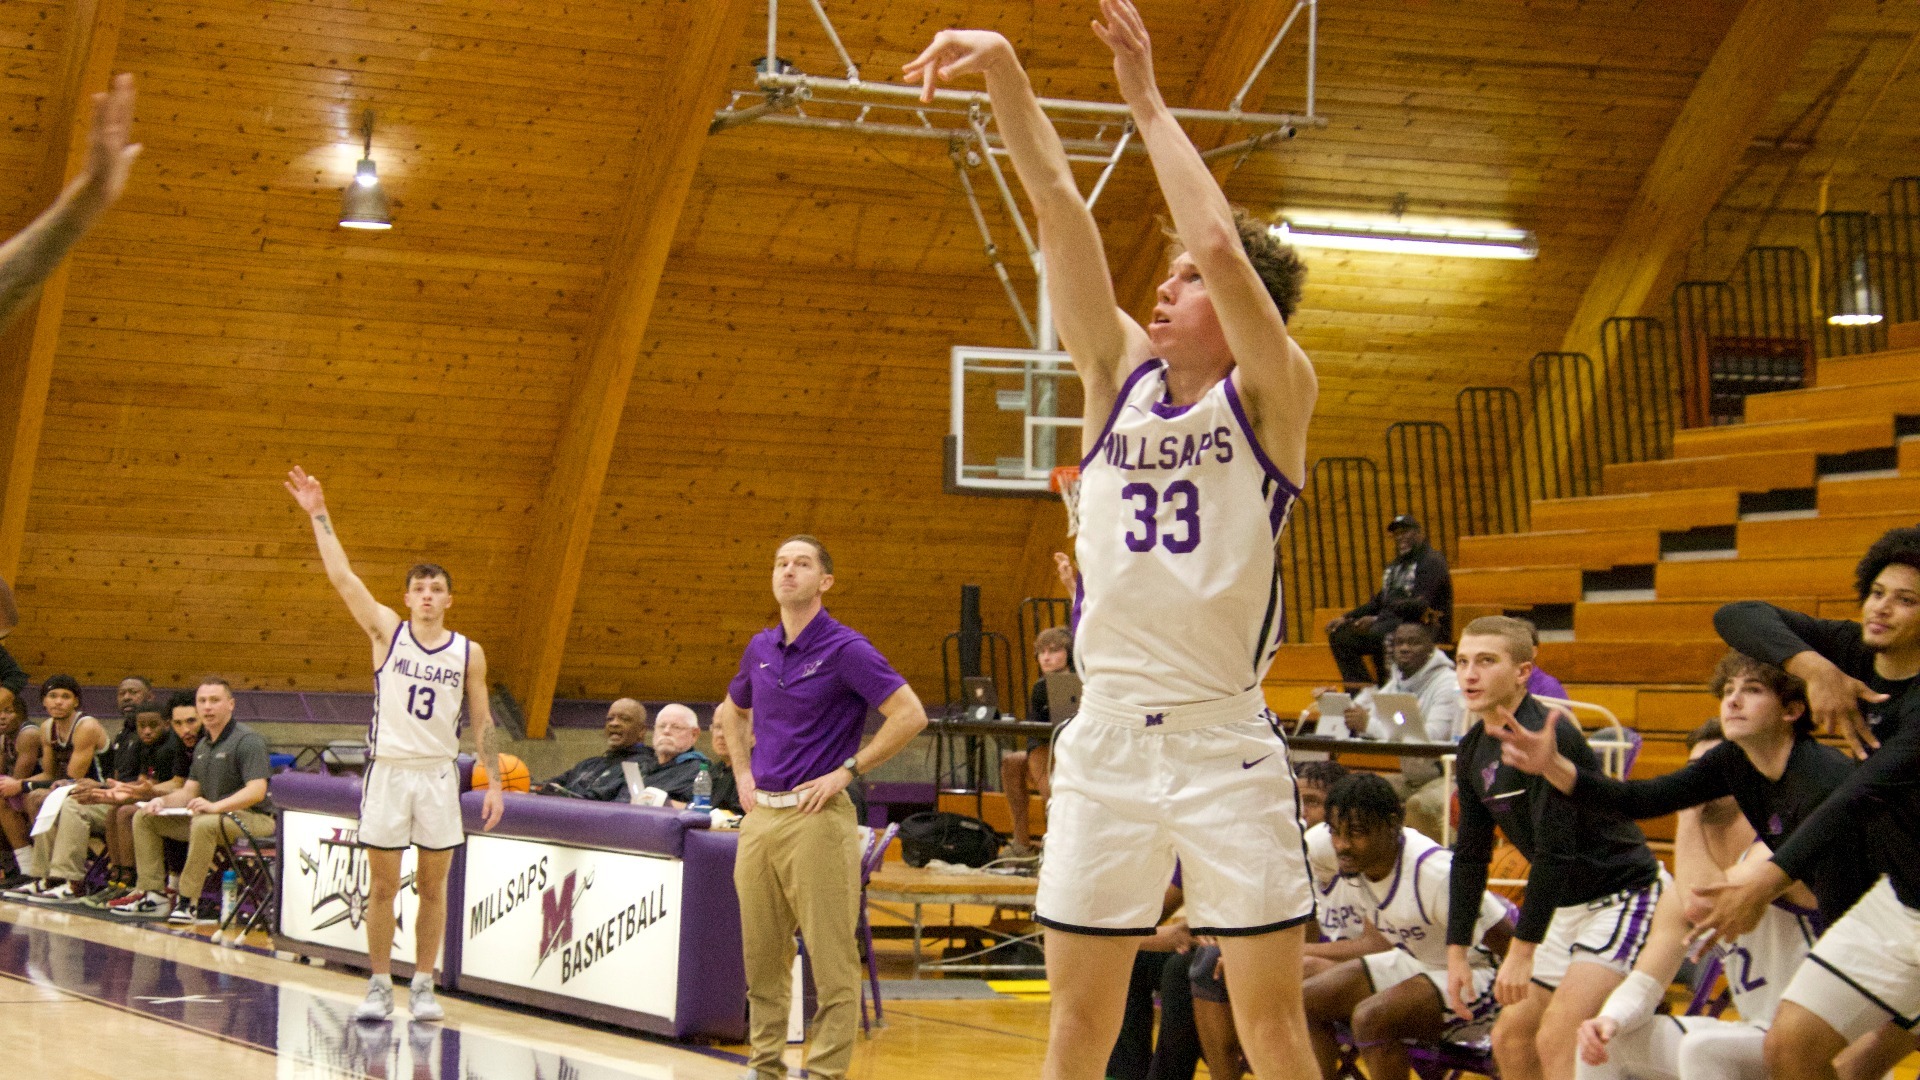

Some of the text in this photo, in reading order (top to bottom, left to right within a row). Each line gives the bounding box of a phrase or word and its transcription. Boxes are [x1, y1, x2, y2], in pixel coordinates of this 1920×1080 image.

[1102, 426, 1233, 470] MILLSAPS
[1122, 480, 1201, 554] 33
[393, 656, 461, 687] MILLSAPS
[407, 684, 436, 720] 13
[470, 855, 548, 939] MILLSAPS
[538, 868, 577, 964] M
[561, 883, 667, 985] BASKETBALL
